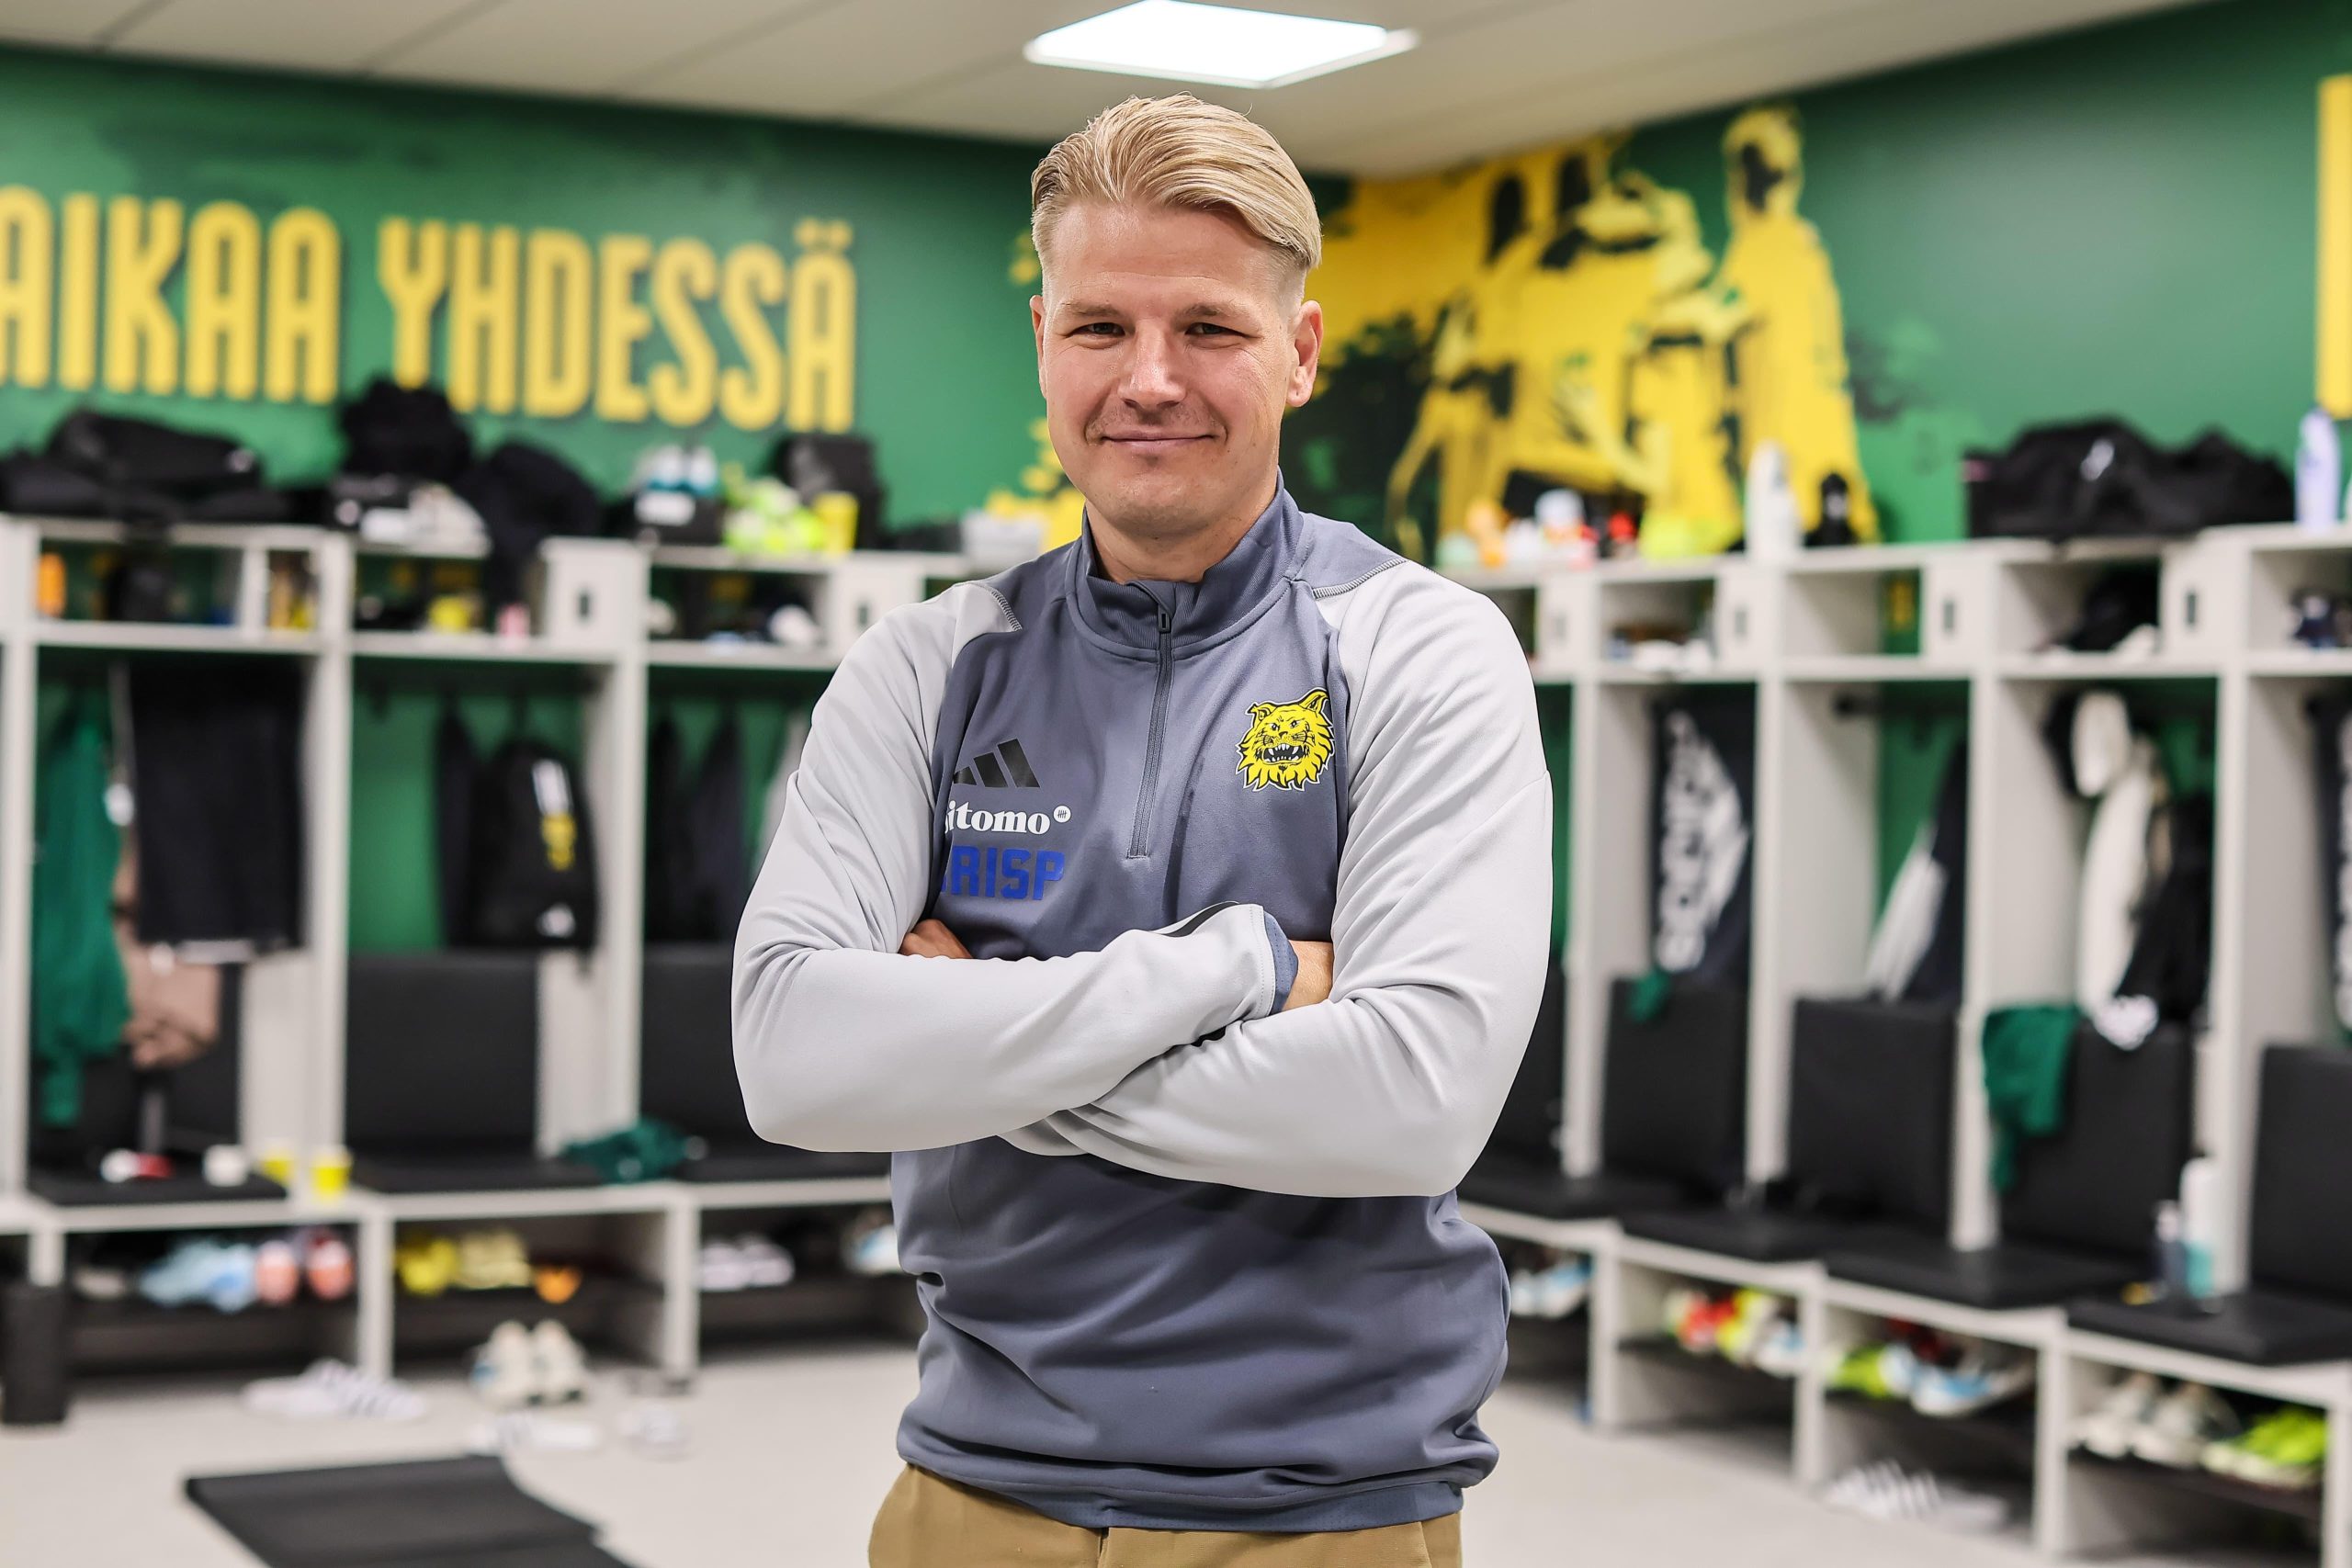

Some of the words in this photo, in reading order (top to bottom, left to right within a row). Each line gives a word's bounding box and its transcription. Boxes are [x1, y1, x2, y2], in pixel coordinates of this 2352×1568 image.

[379, 218, 855, 433] YHDESSÄ
[944, 800, 1051, 835] itomo
[941, 844, 1066, 900] RISP
